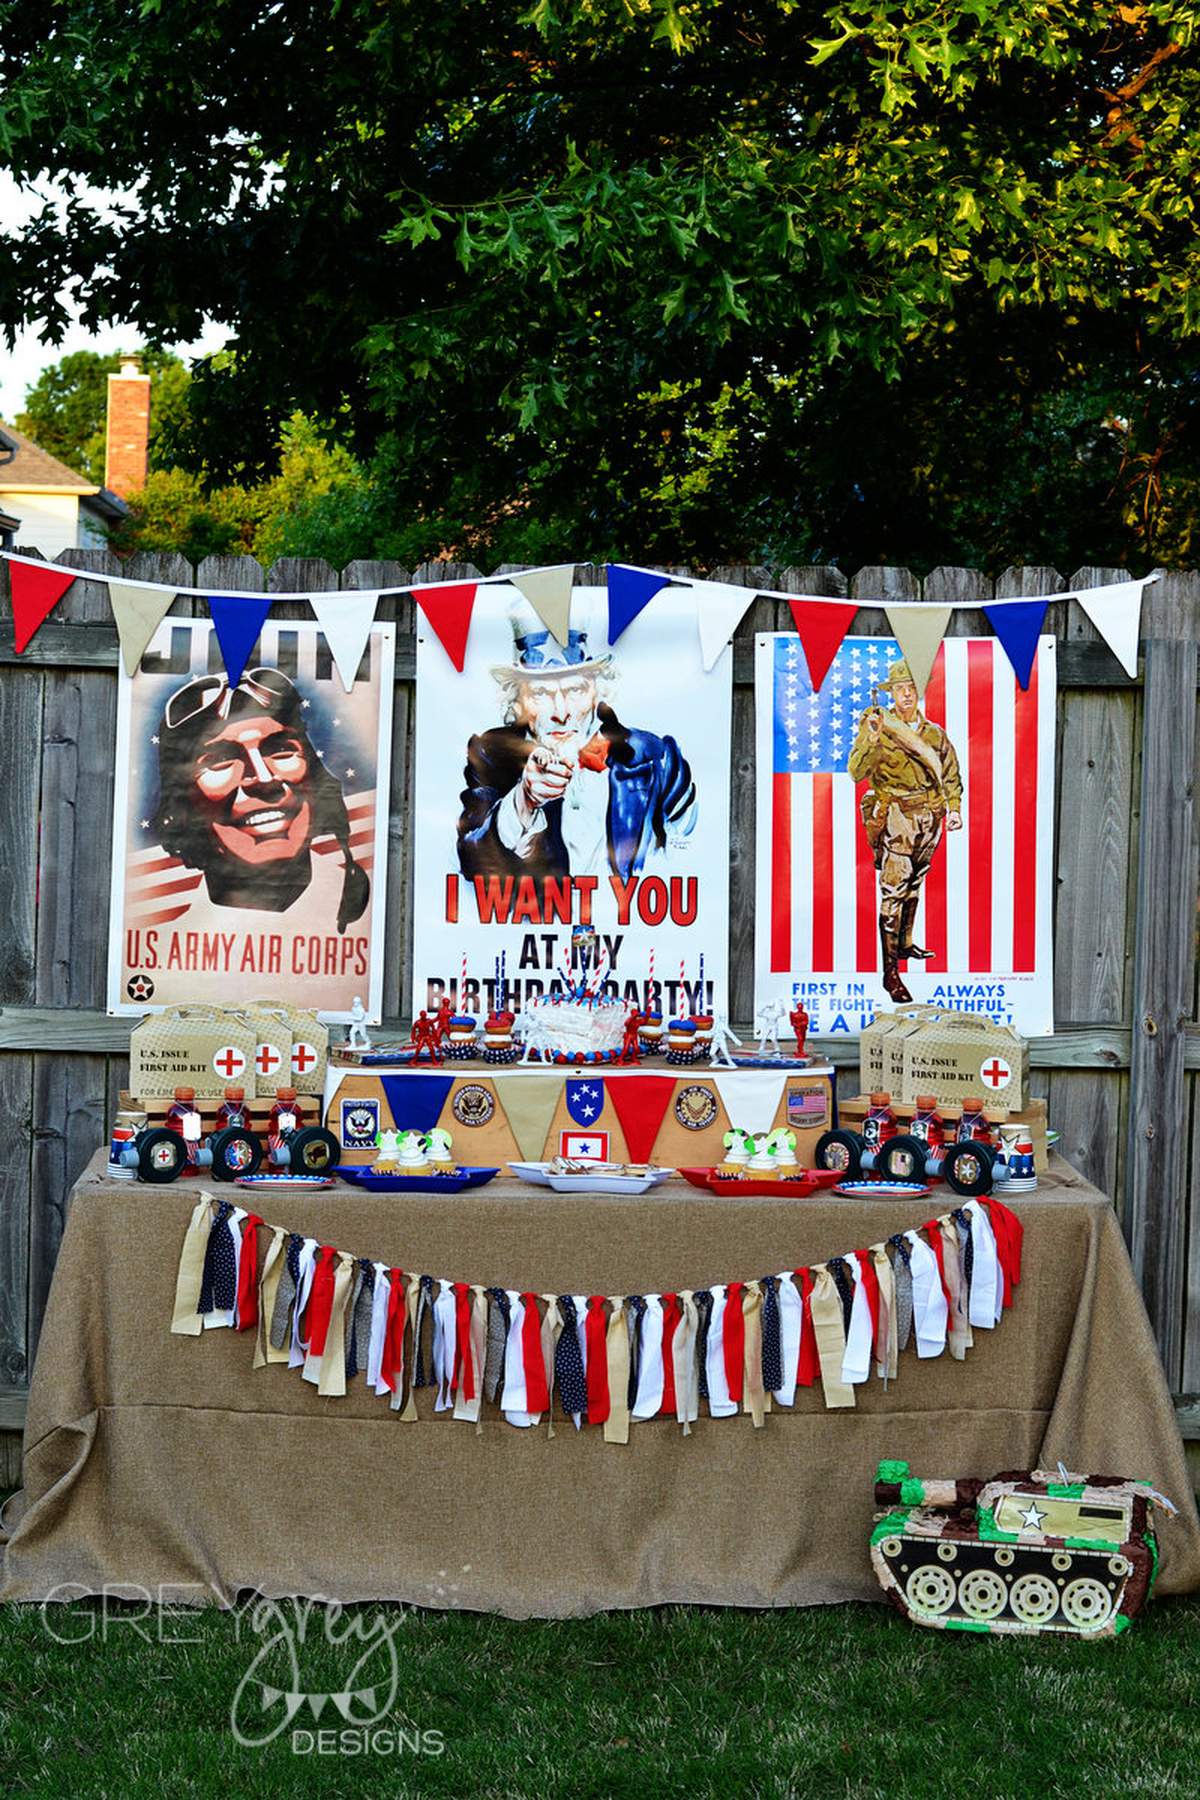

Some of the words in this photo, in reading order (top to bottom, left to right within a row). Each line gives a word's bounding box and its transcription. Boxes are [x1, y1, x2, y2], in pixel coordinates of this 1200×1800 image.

[445, 873, 459, 924] I
[473, 874, 599, 925] WANT
[608, 875, 699, 927] YOU
[126, 929, 162, 969] U.S.
[166, 931, 236, 972] ARMY
[239, 933, 283, 974] AIR
[291, 935, 369, 977] CORPS
[518, 933, 558, 970] AT
[571, 934, 624, 970] MY
[427, 977, 588, 1015] BIRTHDA
[792, 982, 837, 996] FIRST
[848, 983, 864, 996] IN
[933, 984, 1006, 998] ALWAYS
[791, 998, 820, 1011] THE
[829, 1014, 850, 1032] A
[161, 1050, 190, 1058] ISSUE
[140, 1064, 169, 1072] FIRST
[170, 1064, 188, 1072] AID
[189, 1064, 207, 1073] KIT
[931, 1058, 958, 1067] ISSUE
[912, 1070, 938, 1080] FIRST
[940, 1072, 957, 1081] AID
[958, 1073, 975, 1082] KIT
